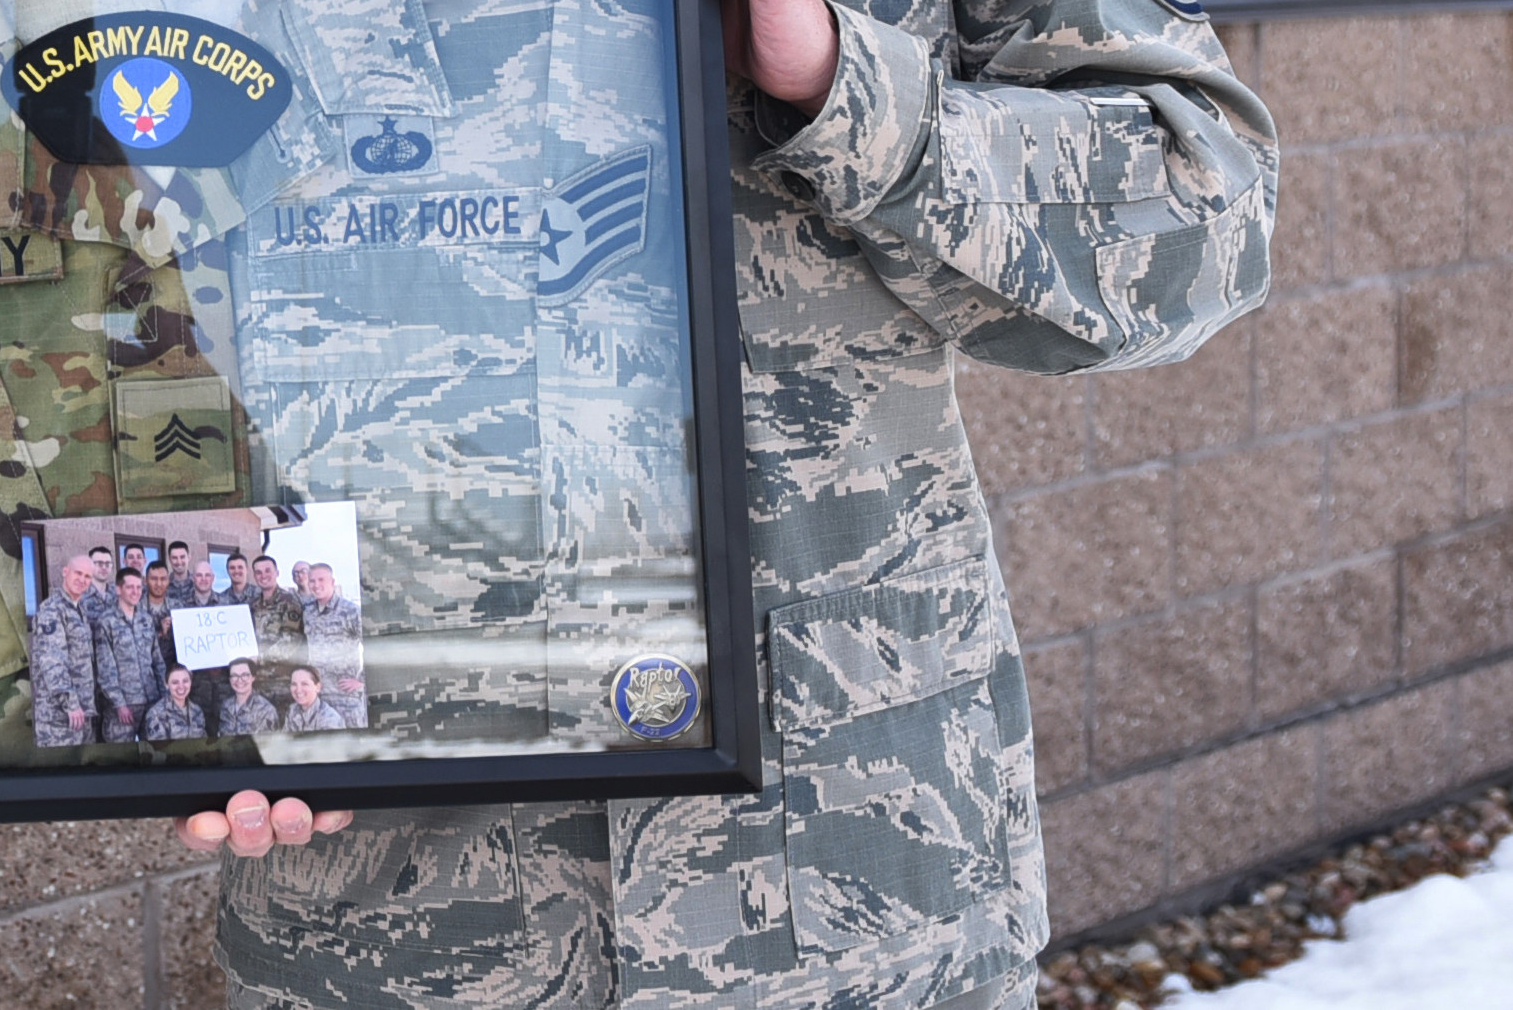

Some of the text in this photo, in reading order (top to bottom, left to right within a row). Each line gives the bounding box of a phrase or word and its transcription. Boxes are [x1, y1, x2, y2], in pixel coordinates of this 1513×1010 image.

[74, 26, 144, 68] ARMY
[144, 26, 189, 60] AIR
[192, 34, 275, 101] CORPS
[274, 195, 521, 247] U.S. AIR FORCE
[183, 631, 249, 657] RAPTOR
[629, 662, 681, 693] Raptor
